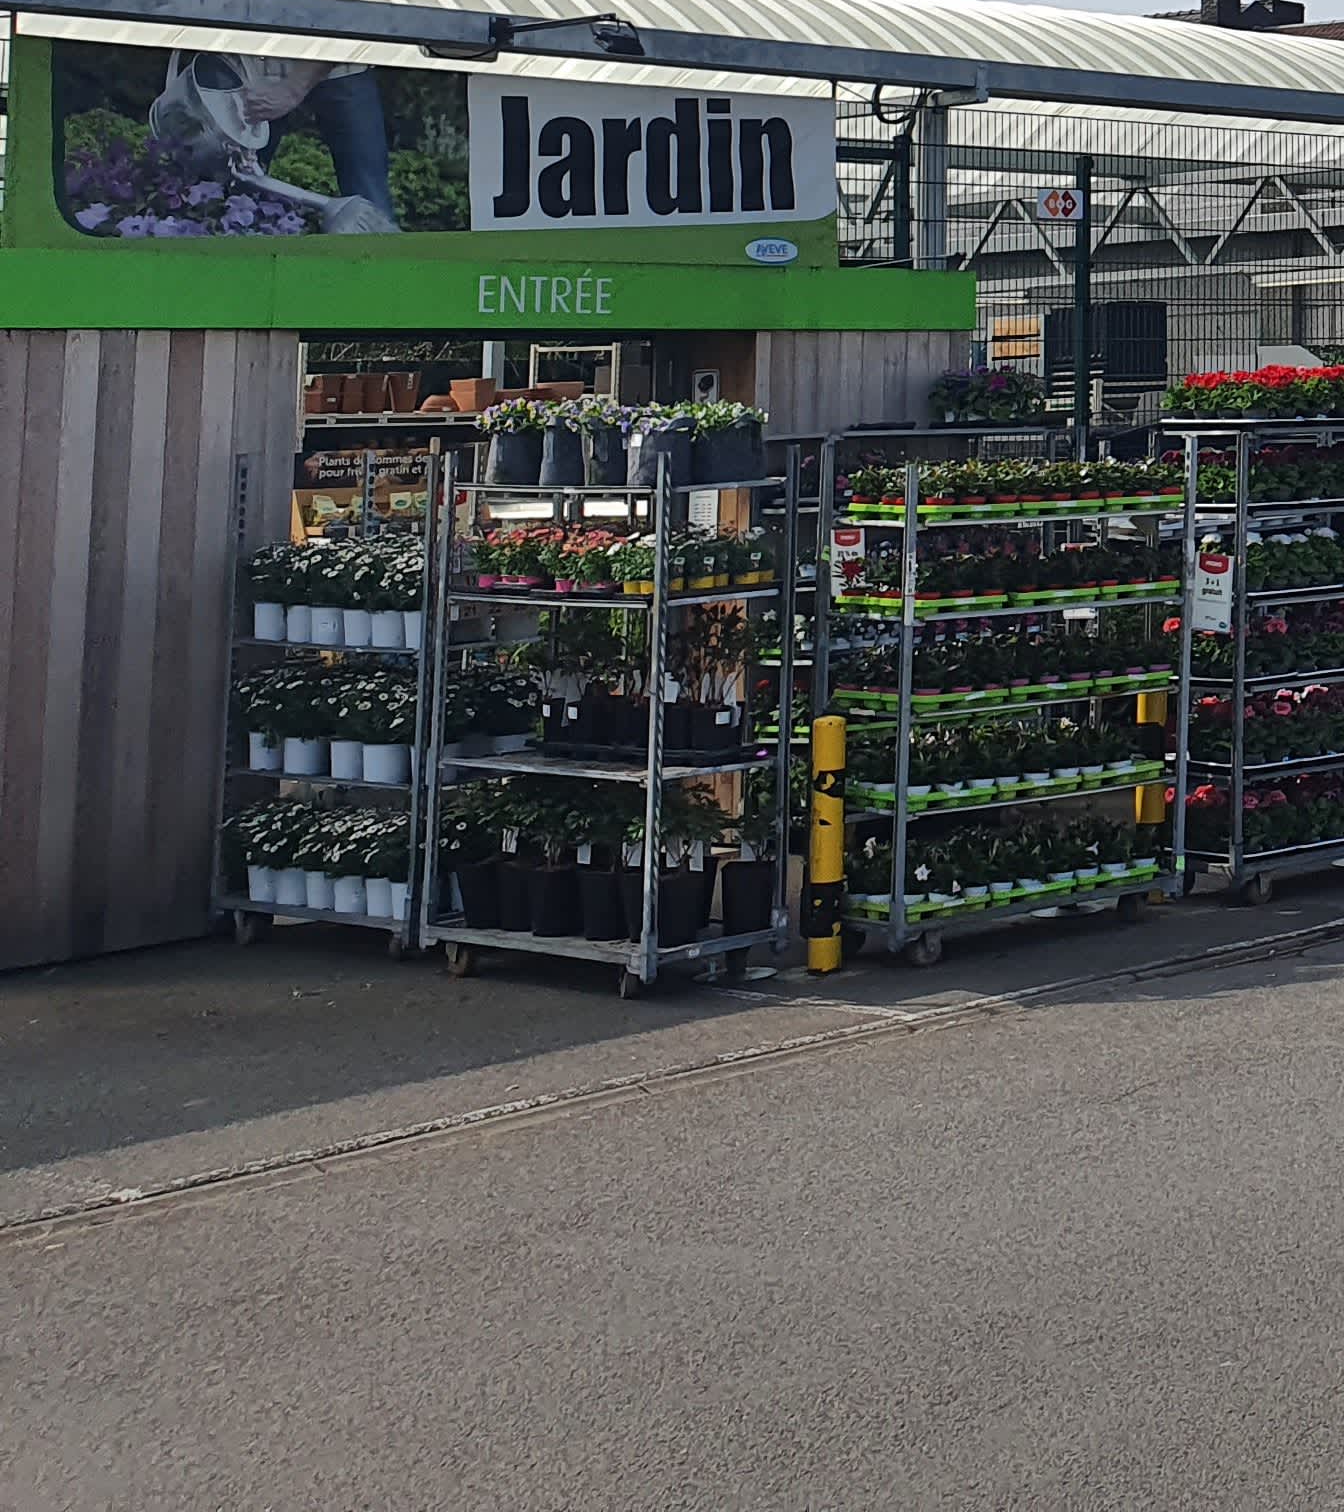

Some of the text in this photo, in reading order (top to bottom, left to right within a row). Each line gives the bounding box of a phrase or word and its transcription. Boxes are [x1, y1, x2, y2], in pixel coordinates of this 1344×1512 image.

[492, 95, 796, 219] Jardin
[477, 267, 613, 315] ENTRÉE
[318, 455, 350, 467] Plants
[372, 454, 413, 465] ommes
[318, 468, 344, 480] pour
